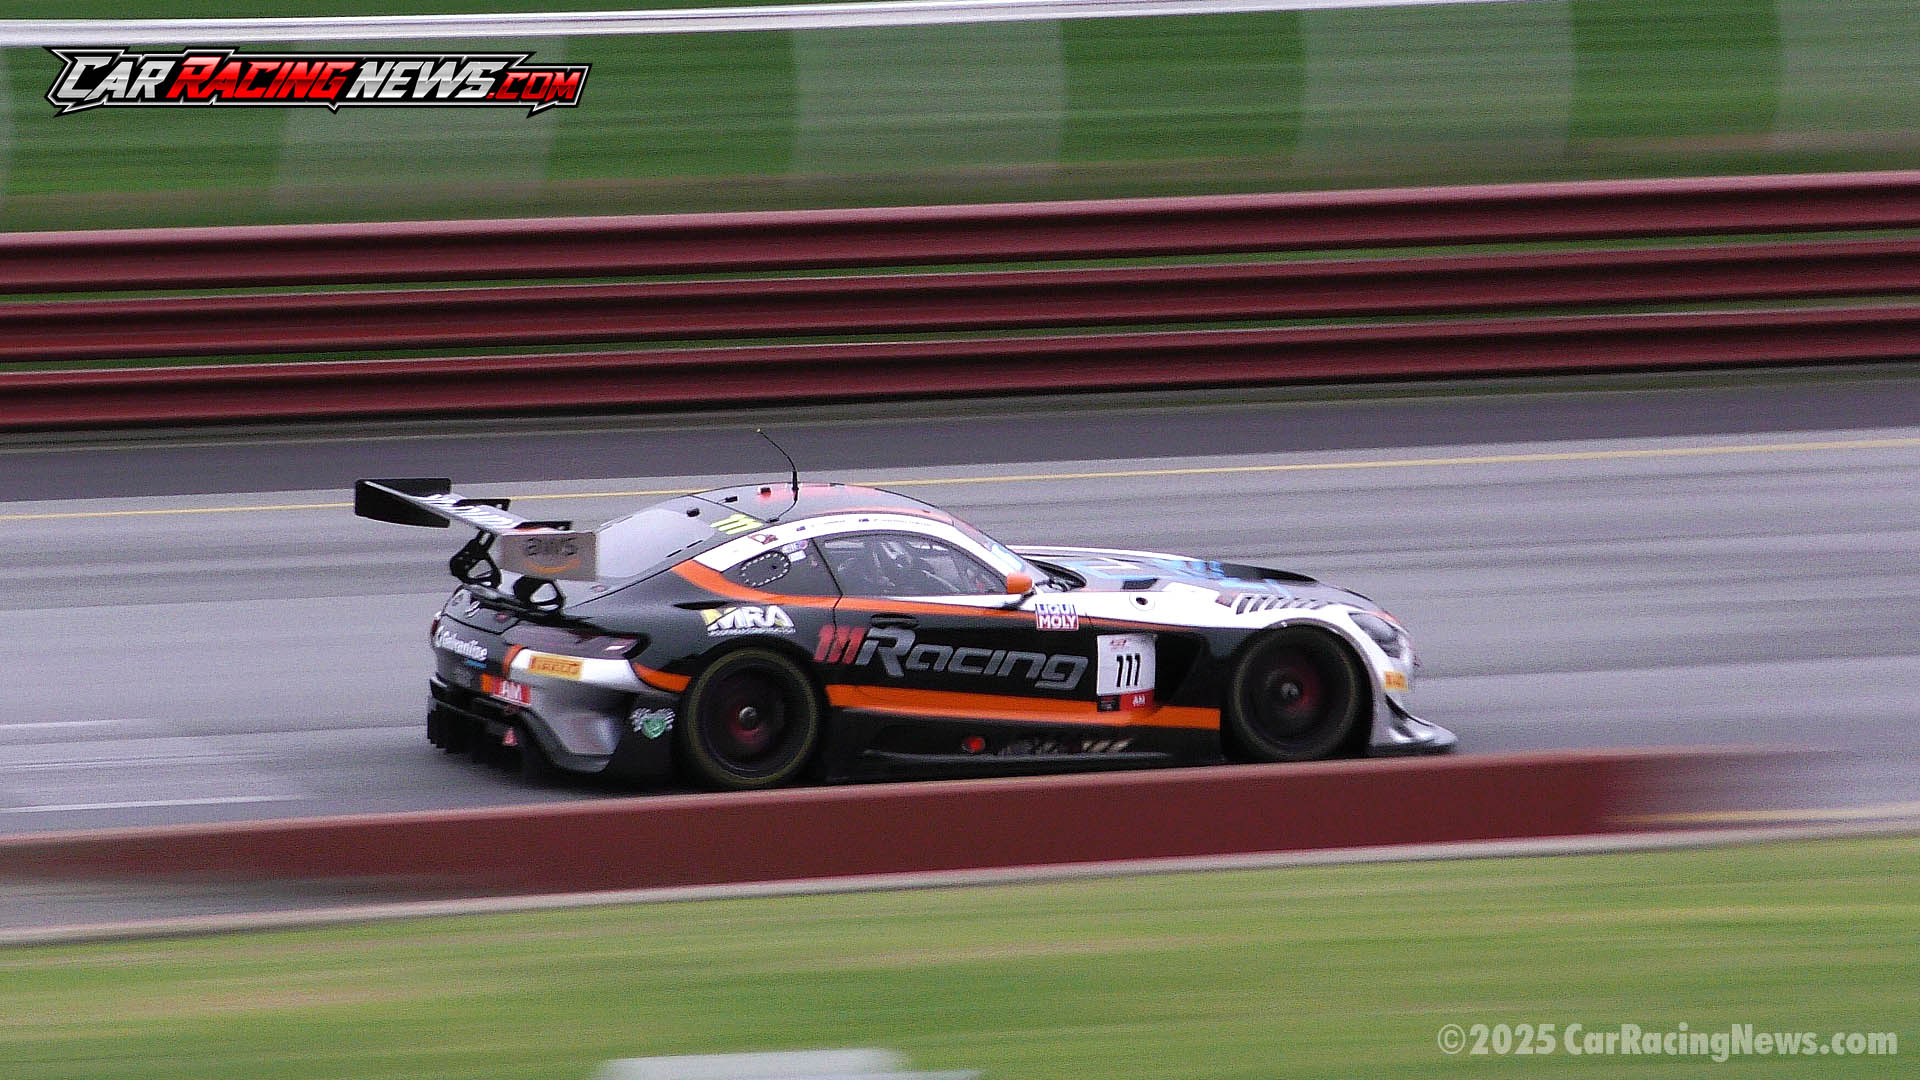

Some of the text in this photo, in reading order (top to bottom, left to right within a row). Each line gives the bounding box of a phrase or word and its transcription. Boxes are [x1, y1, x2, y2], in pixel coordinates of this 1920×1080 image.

[1035, 603, 1077, 616] LIQUI
[1038, 614, 1077, 630] MOLY
[1115, 653, 1141, 688] 111
